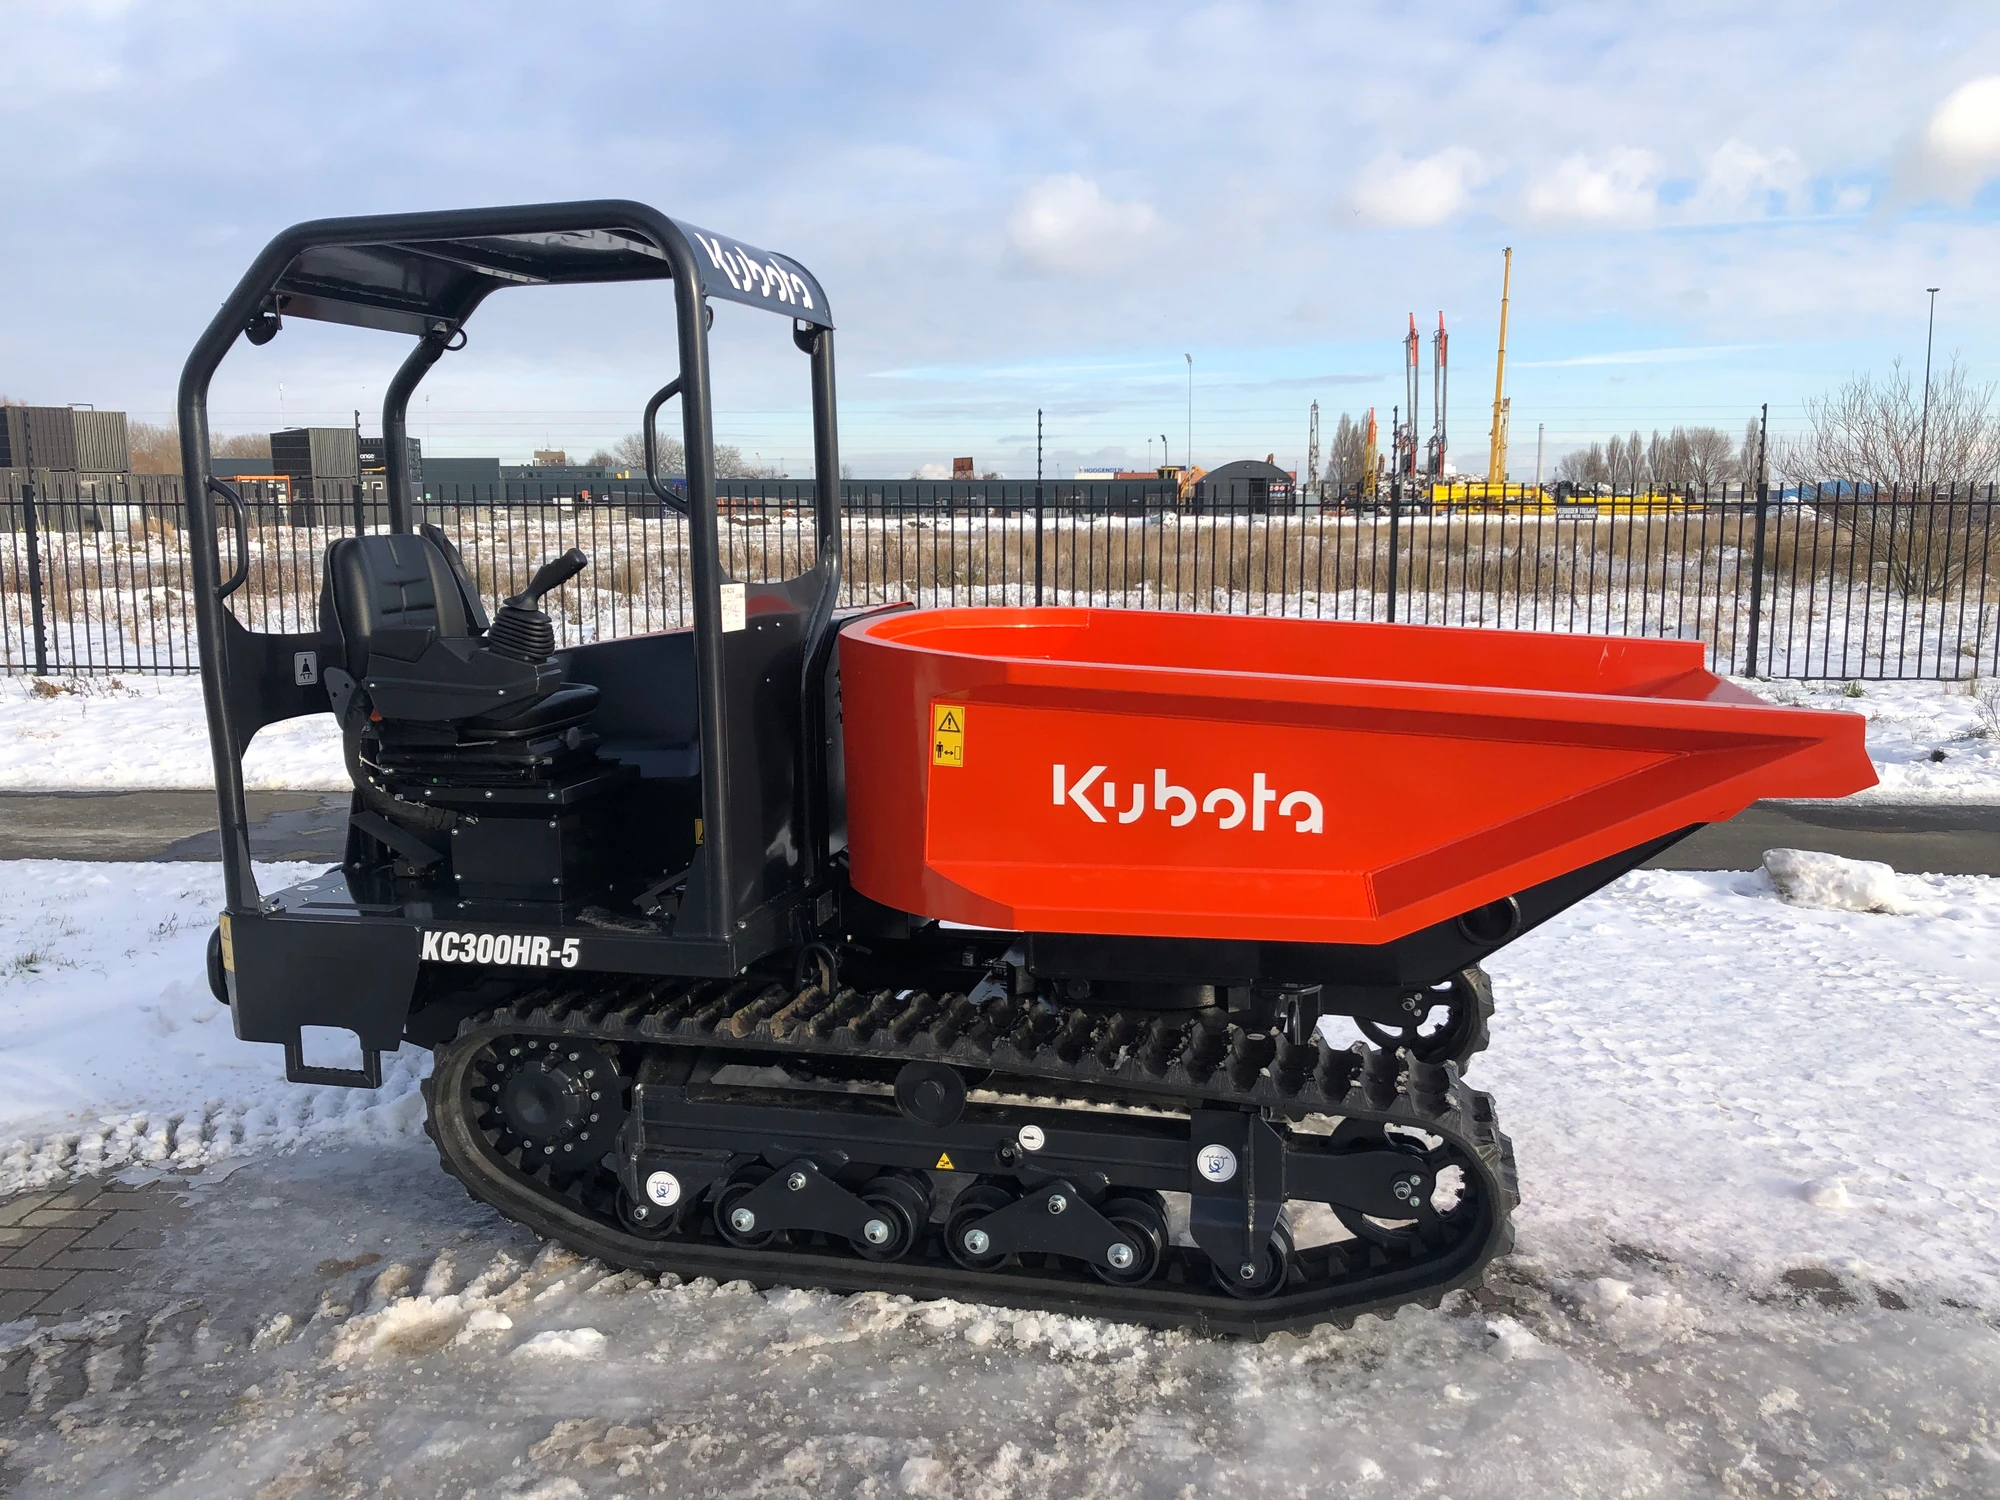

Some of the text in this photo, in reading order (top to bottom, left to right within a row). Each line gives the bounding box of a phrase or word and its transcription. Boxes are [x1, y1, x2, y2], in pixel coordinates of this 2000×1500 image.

[694, 232, 813, 310] Kubota
[1052, 764, 1323, 834] Kubota
[421, 931, 580, 968] KC300HR-5
